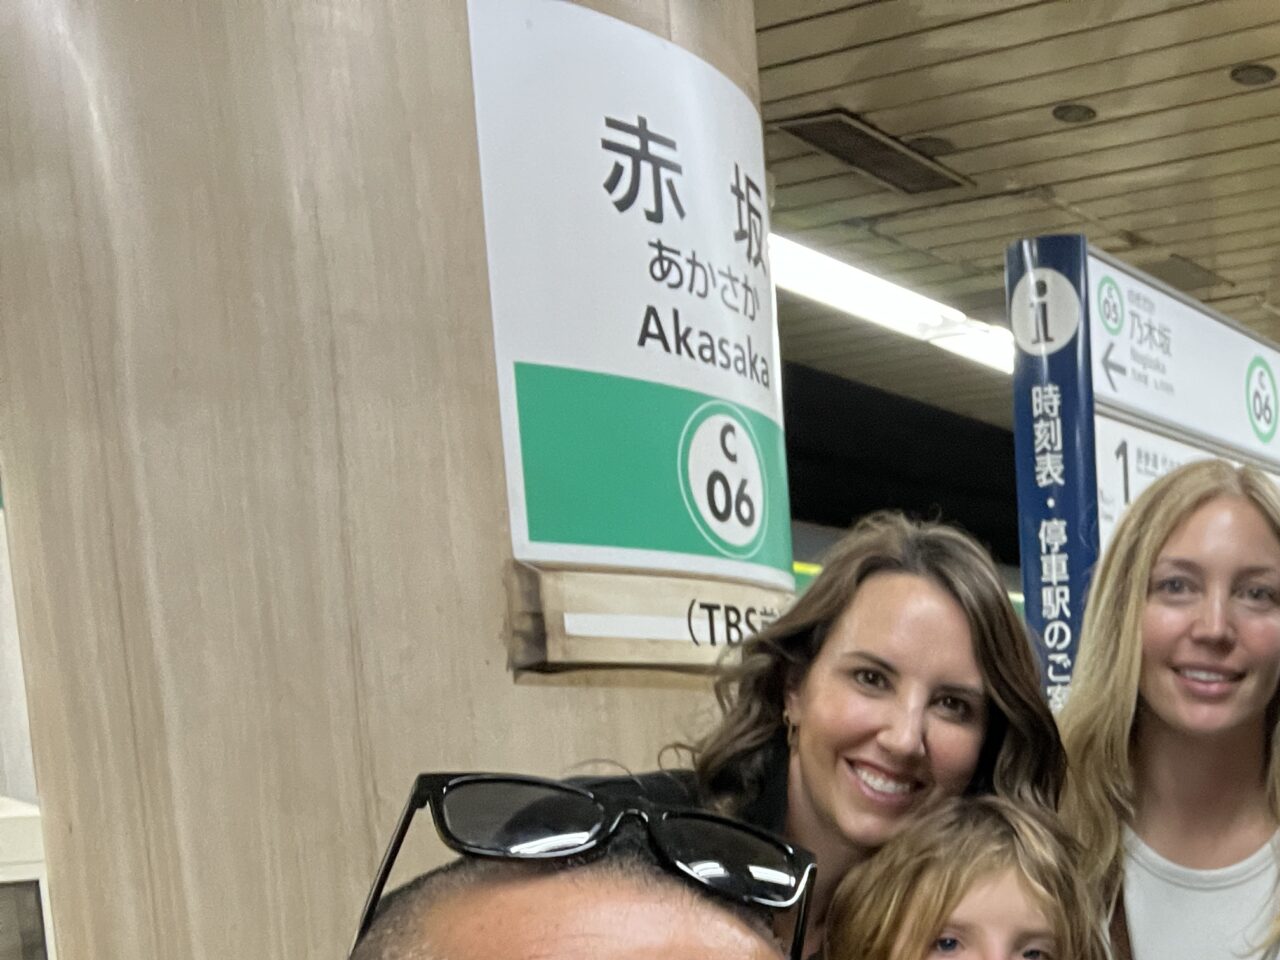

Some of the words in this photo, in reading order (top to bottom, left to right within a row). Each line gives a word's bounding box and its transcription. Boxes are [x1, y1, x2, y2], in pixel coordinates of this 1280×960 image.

[600, 114, 767, 276] 赤坂
[648, 238, 761, 322] あかさか
[637, 304, 771, 390] Akasaka
[719, 417, 738, 464] C
[1252, 389, 1273, 426] 06
[706, 468, 756, 528] 06
[1114, 439, 1130, 505] 1
